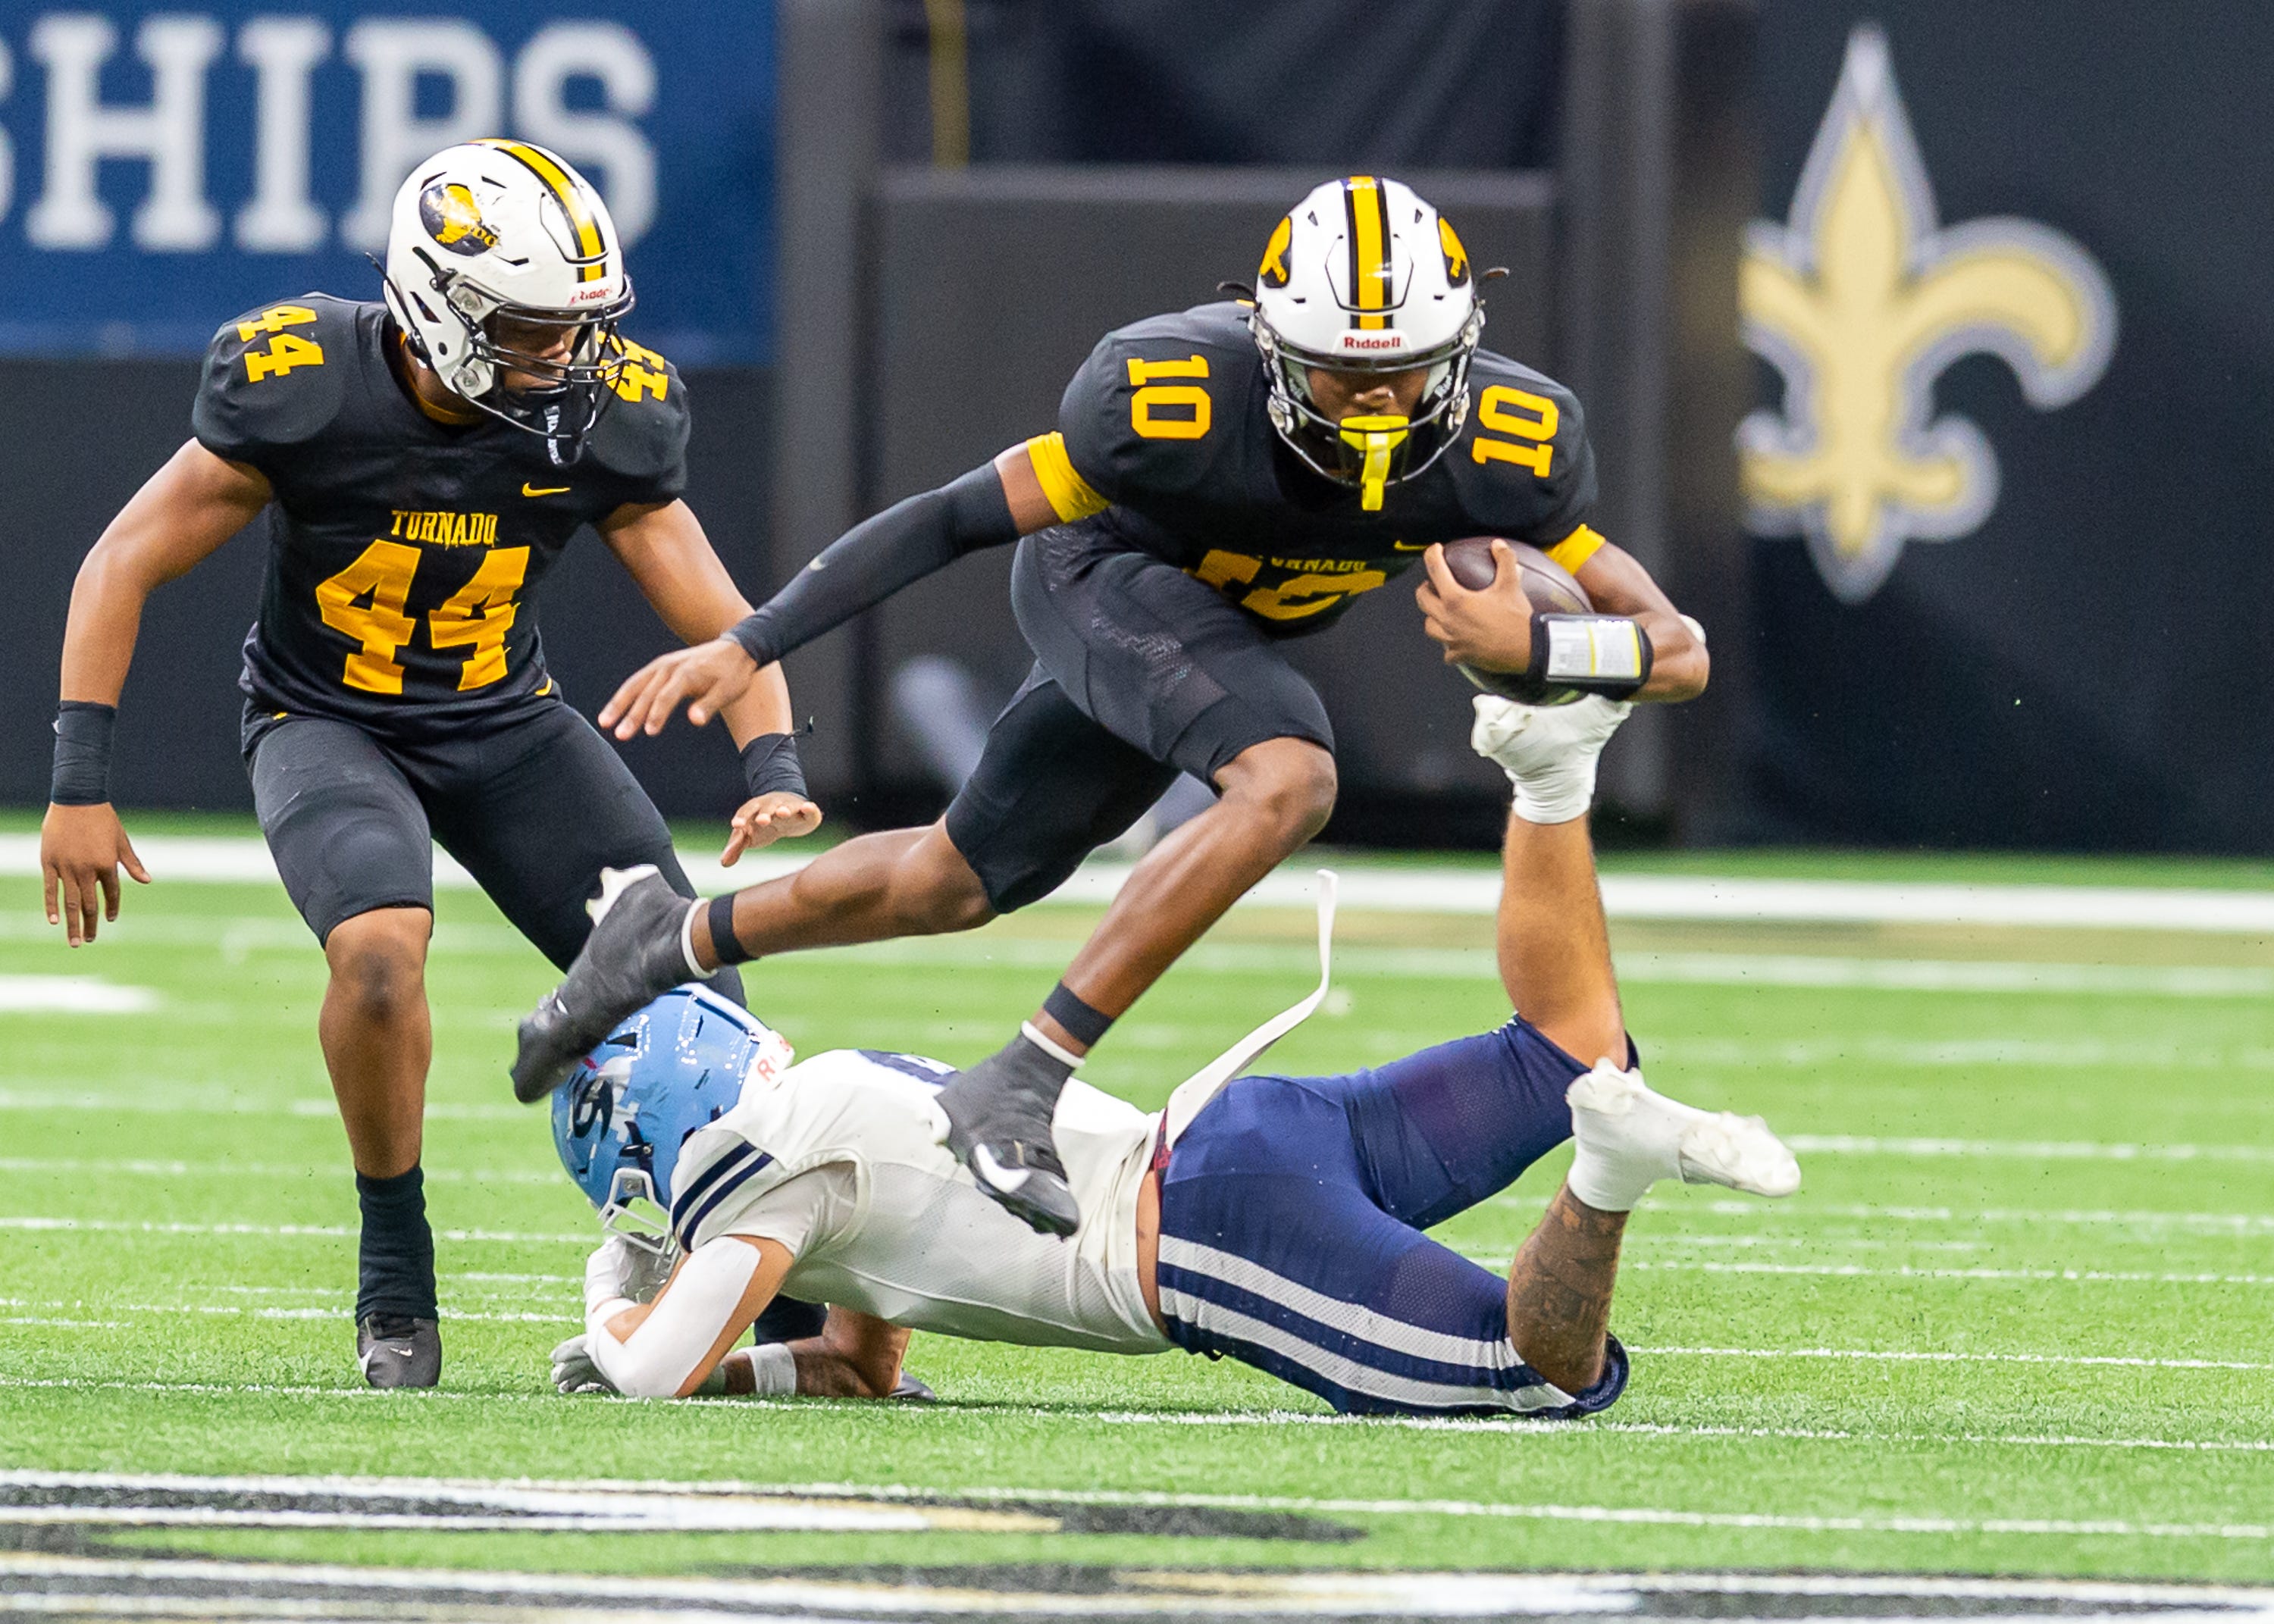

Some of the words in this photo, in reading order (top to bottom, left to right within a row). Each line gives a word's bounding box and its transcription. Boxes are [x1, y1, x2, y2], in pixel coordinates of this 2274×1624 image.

[0, 14, 659, 253] HIPS
[236, 305, 324, 383] 44
[1344, 336, 1401, 349] Riddell
[1126, 355, 1211, 440] 10
[1472, 385, 1559, 478] 10
[391, 509, 498, 547] TORNADO
[315, 539, 531, 696] 44
